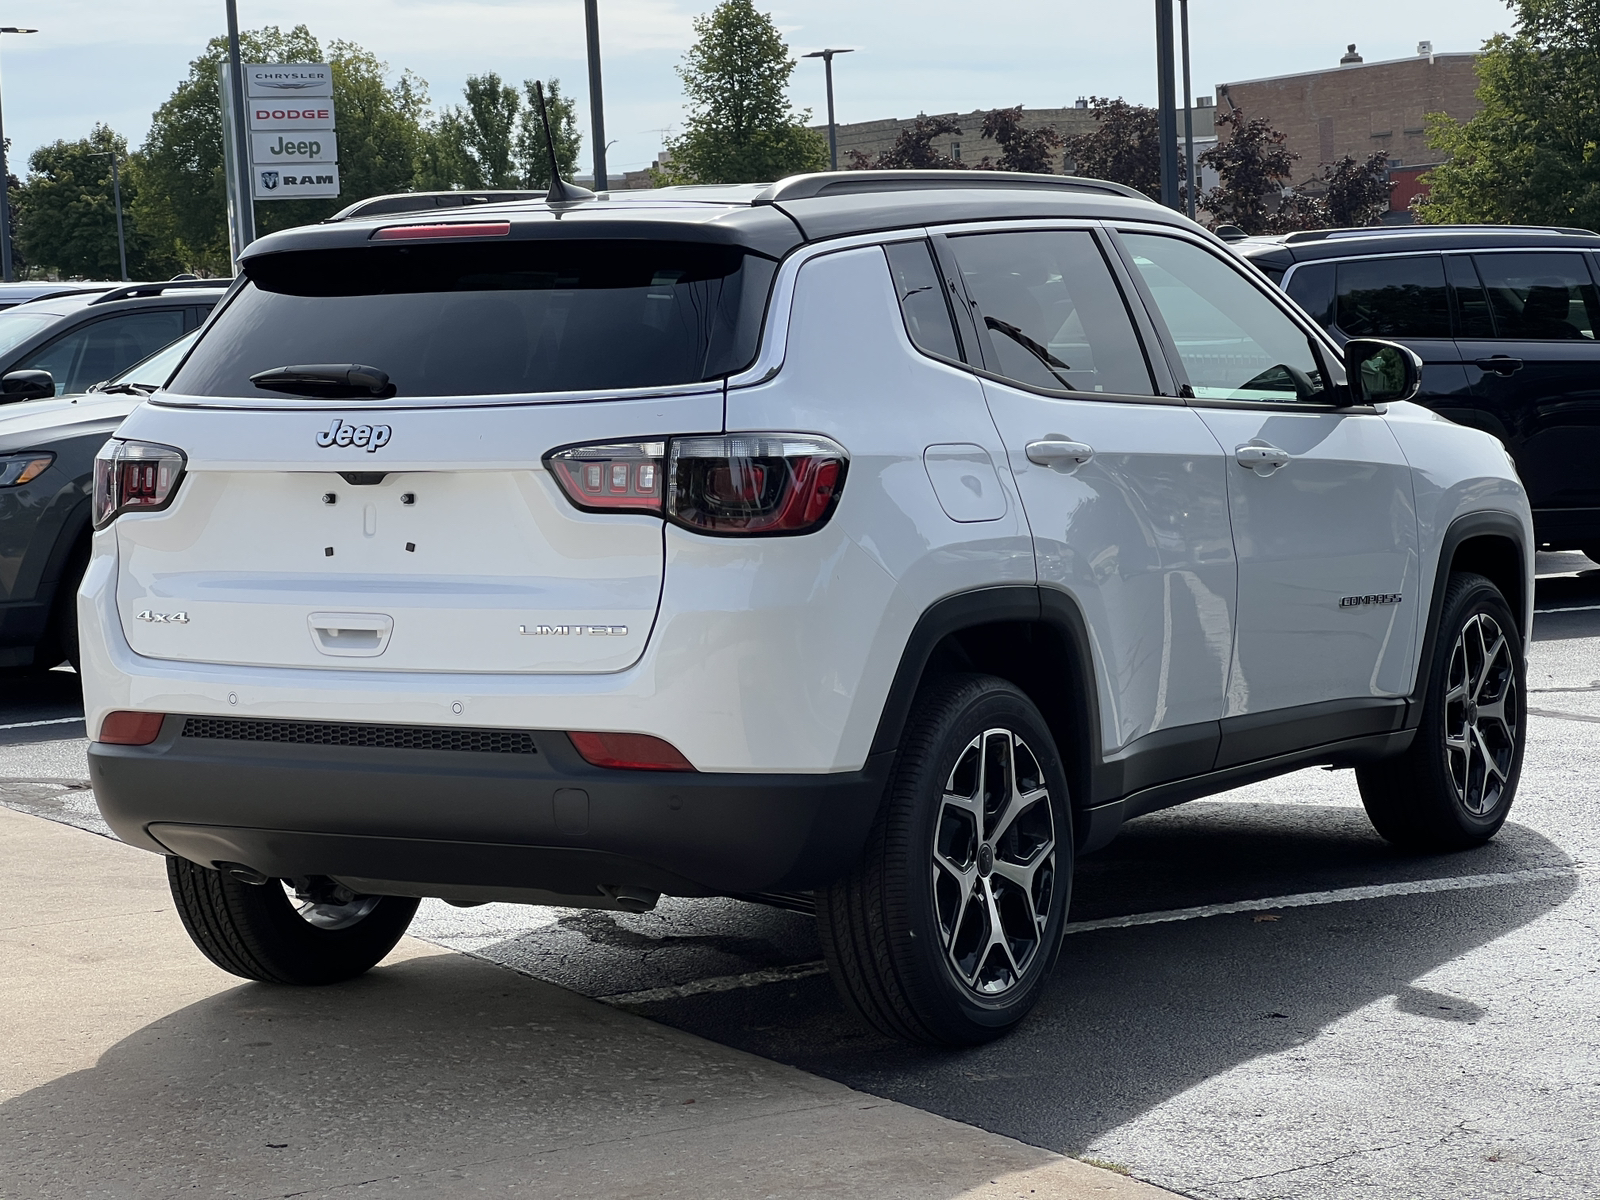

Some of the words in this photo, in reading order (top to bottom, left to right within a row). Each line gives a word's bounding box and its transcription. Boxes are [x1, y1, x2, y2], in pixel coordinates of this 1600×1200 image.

[256, 109, 329, 120] DODGE
[270, 136, 321, 158] Jeep
[283, 175, 334, 185] RAM
[316, 418, 392, 453] Jeep
[1339, 592, 1403, 608] COMPASS
[136, 609, 190, 624] 4x4
[519, 624, 629, 636] LIMITED
